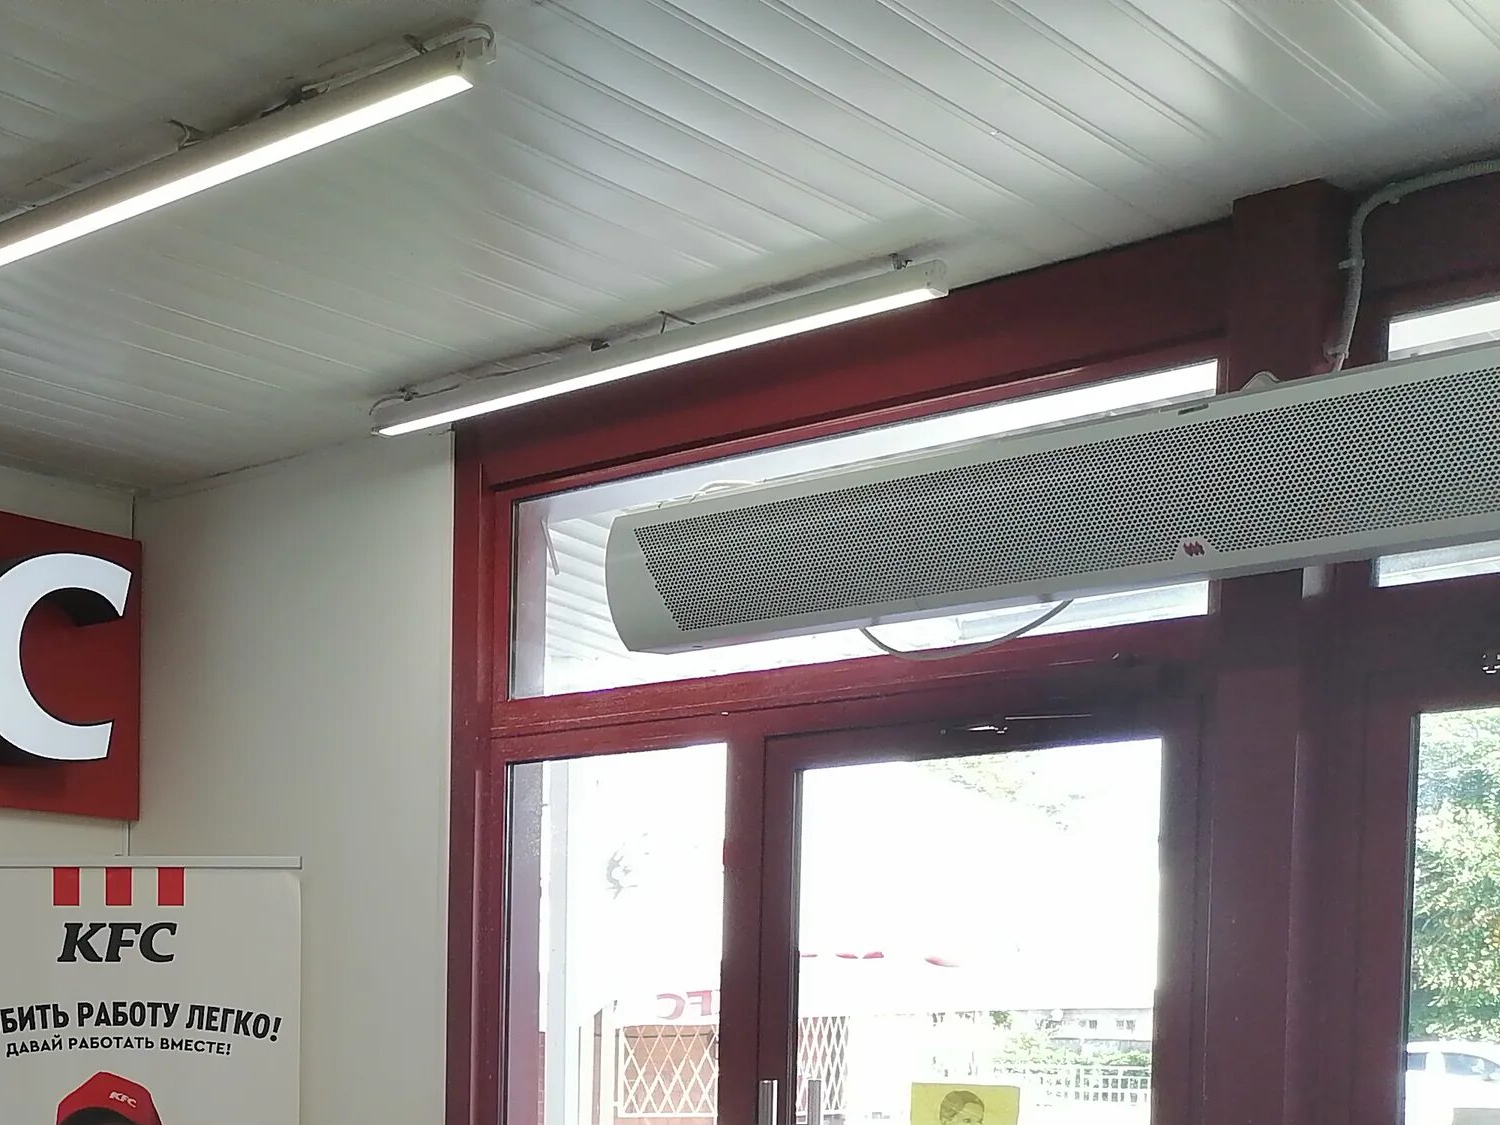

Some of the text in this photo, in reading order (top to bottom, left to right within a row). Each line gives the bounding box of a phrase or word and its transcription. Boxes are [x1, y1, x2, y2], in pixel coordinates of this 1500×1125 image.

[57, 922, 177, 962] KFC
[77, 1002, 180, 1028] РАБОТУ
[186, 1004, 283, 1042] ЛЕГКО!
[6, 1034, 231, 1058] ДАВАЙ РАБОТАТЬ ВМЕСТЕ!
[109, 1092, 137, 1108] KFC
